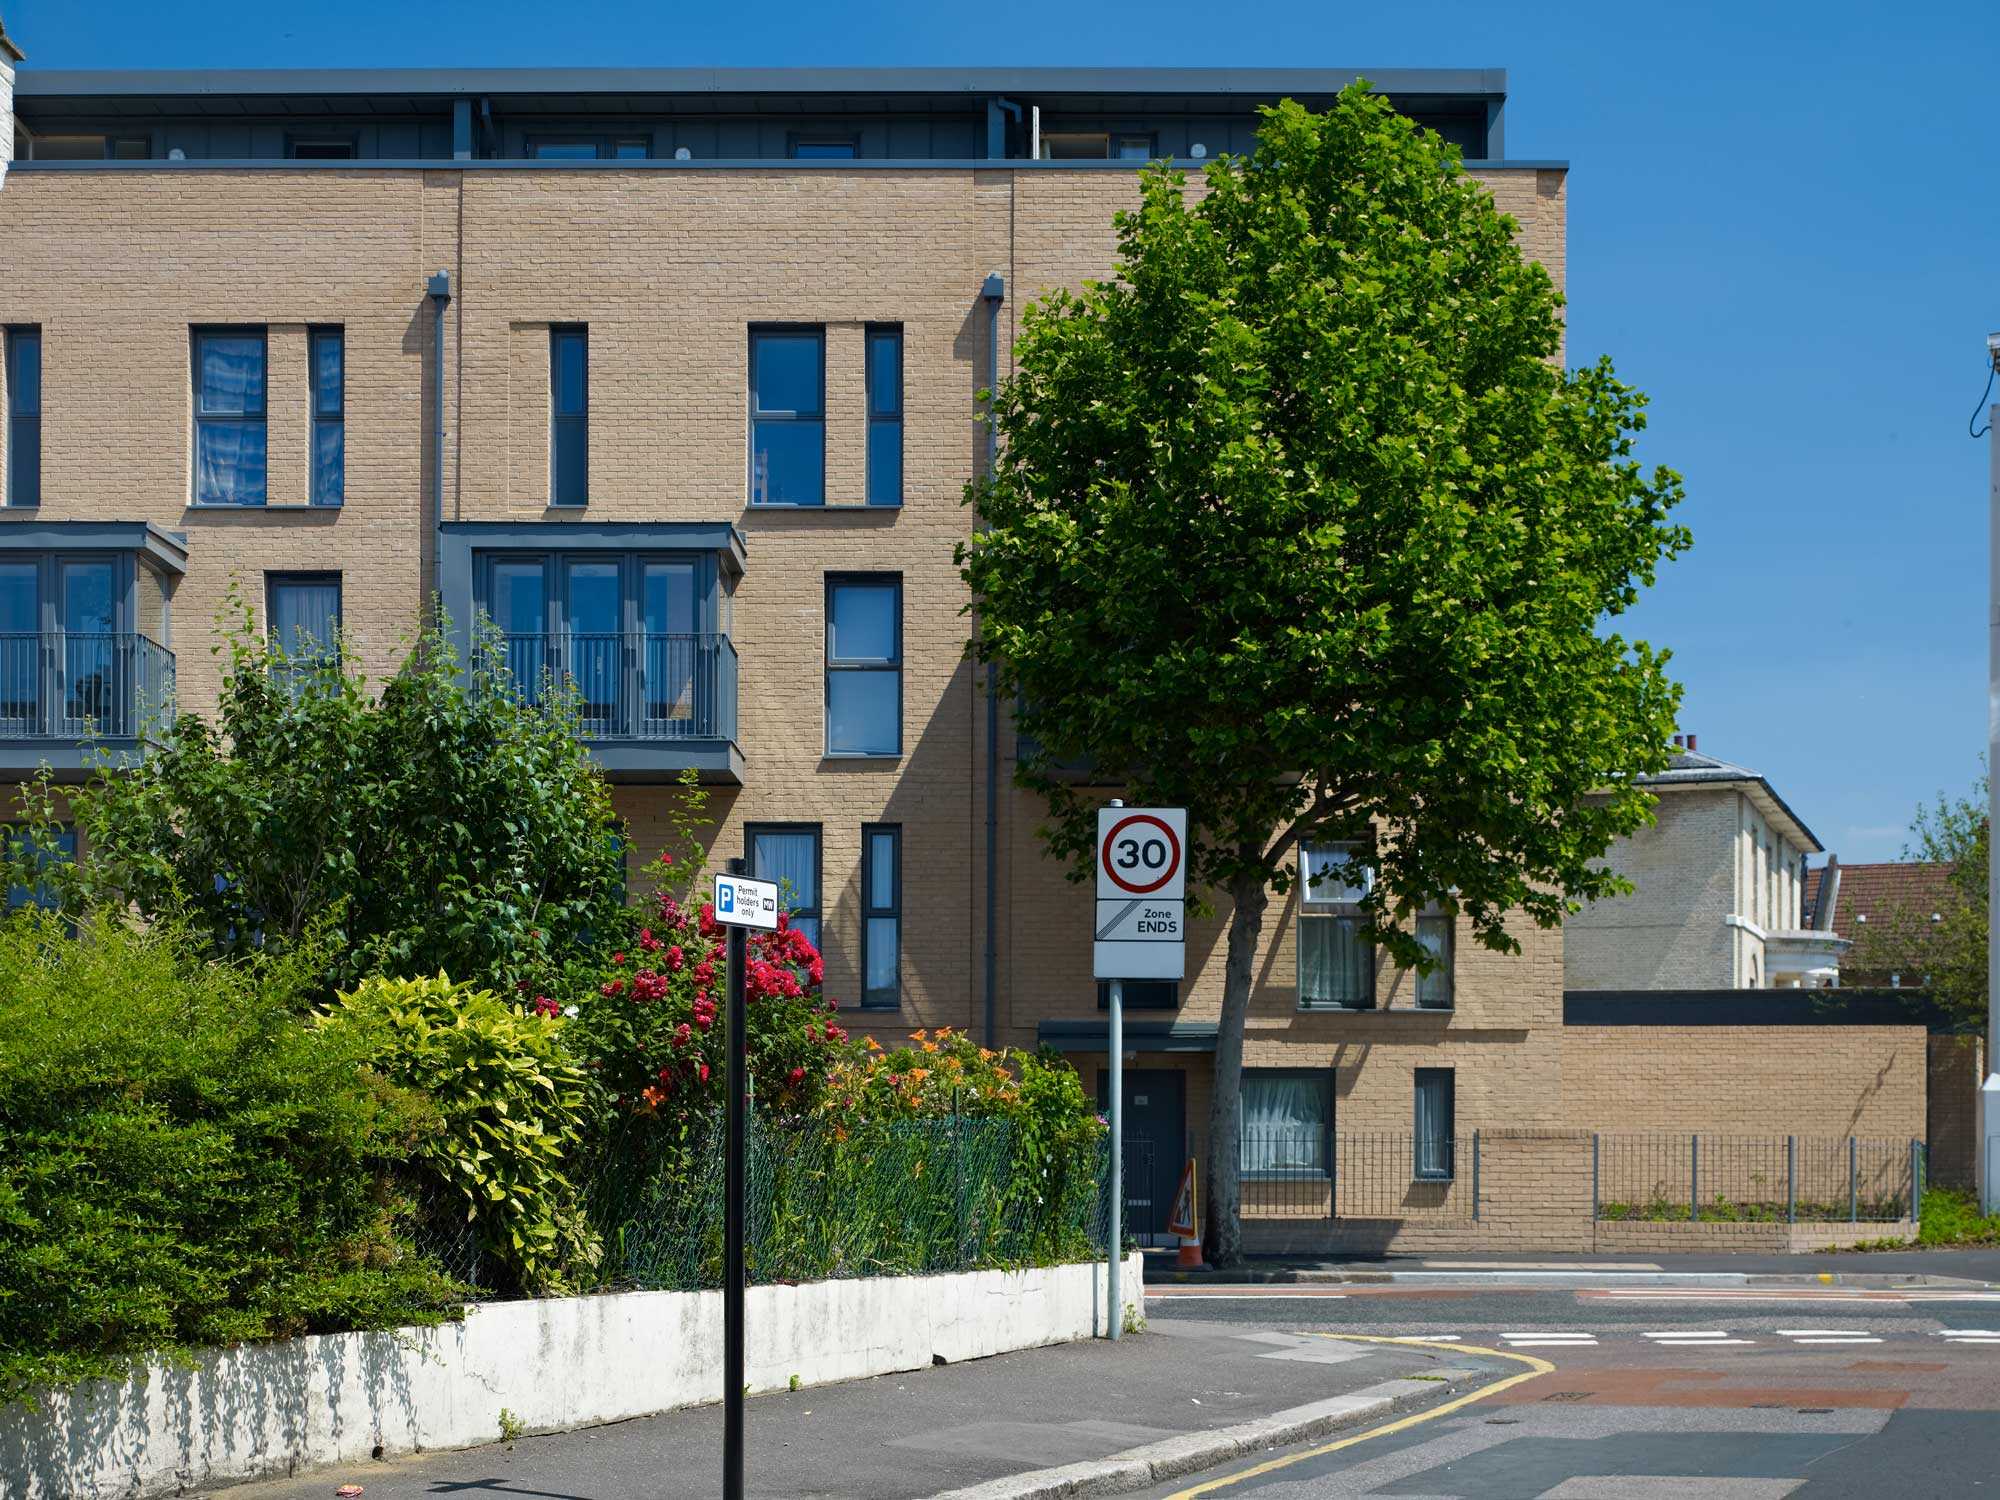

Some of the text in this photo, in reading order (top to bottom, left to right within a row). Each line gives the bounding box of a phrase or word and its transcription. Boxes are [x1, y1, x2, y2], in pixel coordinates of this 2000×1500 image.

[1117, 839, 1167, 869] 30
[738, 885, 758, 897] Permit
[721, 887, 731, 909] P
[737, 895, 760, 907] holders
[763, 900, 774, 910] MW
[741, 908, 755, 918] only
[1144, 909, 1172, 919] Zone
[1138, 921, 1177, 933] ENDS
